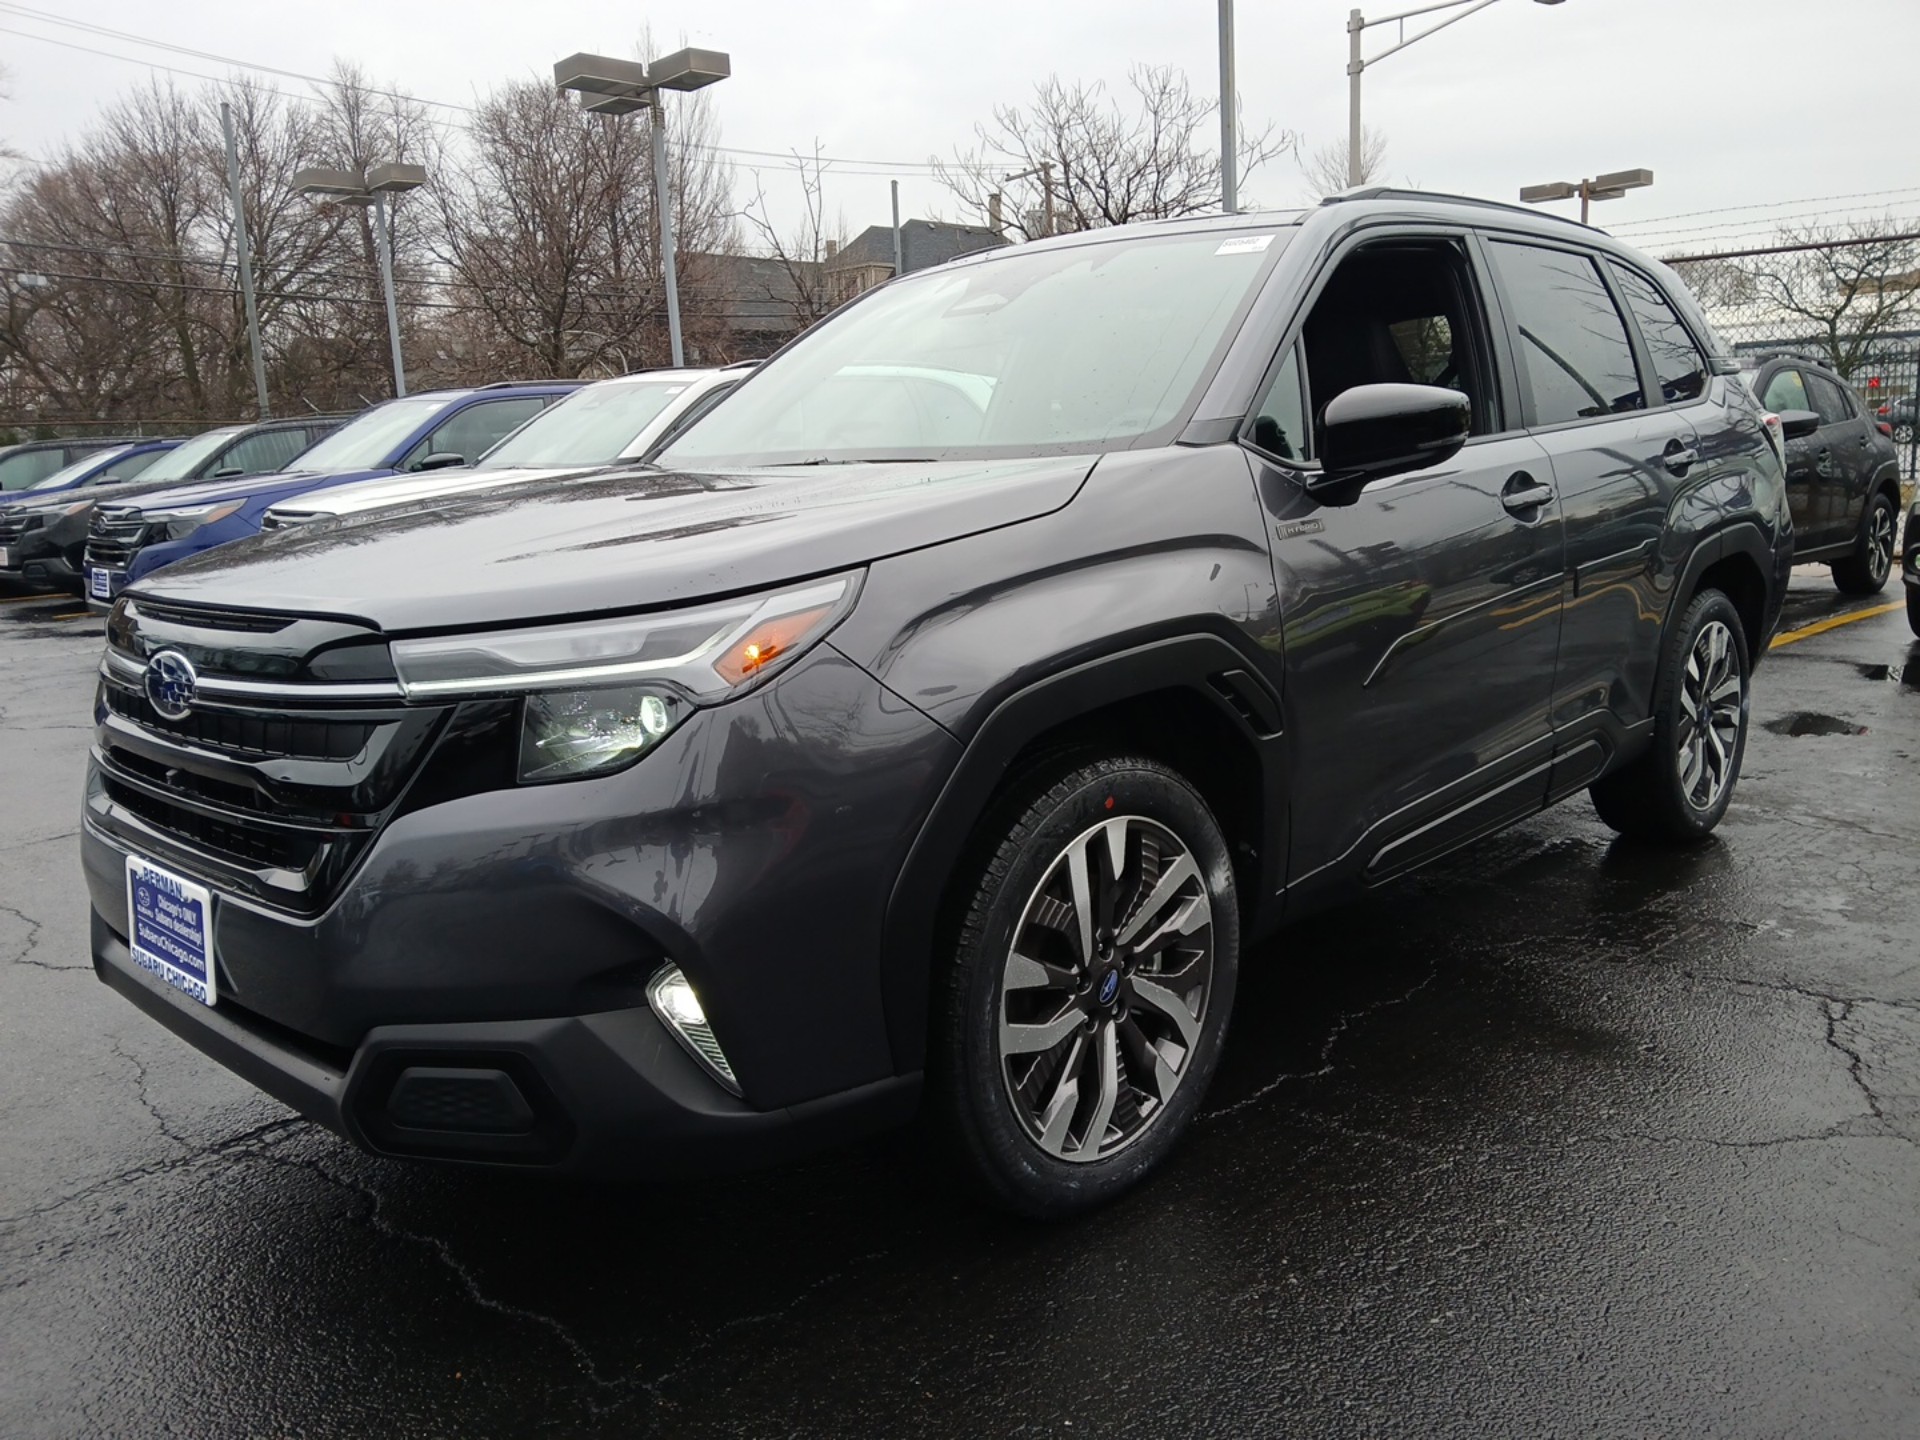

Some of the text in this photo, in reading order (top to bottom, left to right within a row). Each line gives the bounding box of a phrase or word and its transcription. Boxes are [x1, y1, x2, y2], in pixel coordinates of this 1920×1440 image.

[142, 865, 183, 898] BERMAN
[154, 908, 173, 930] Subaru
[137, 923, 205, 972] SubaruChicago.com
[131, 948, 208, 1002] SUBARU CHICAGO
